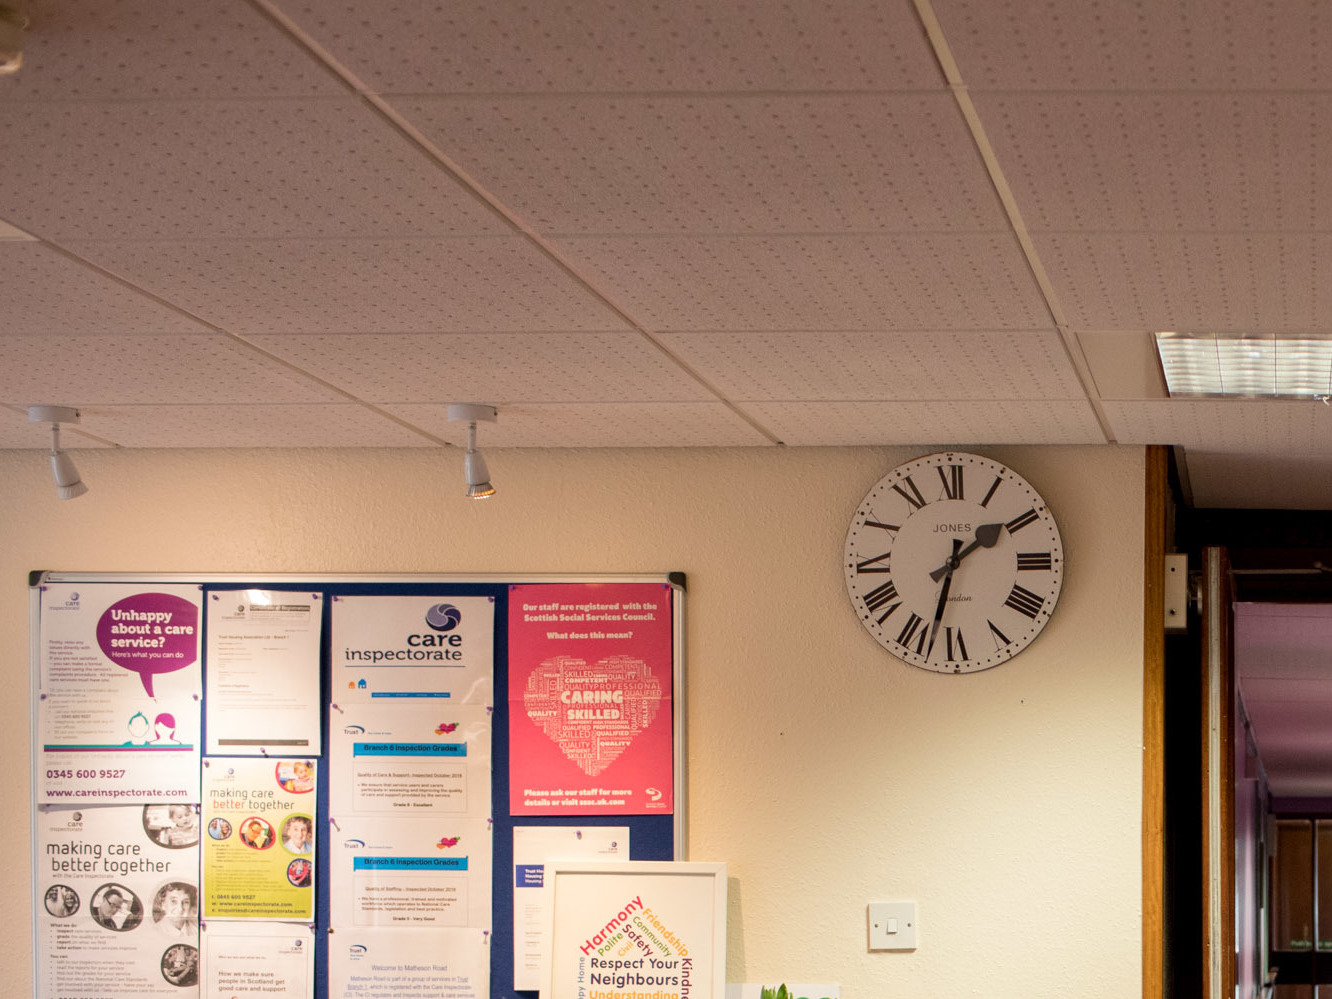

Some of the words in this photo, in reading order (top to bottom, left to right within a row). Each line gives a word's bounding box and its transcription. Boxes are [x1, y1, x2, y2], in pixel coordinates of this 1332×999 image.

[933, 524, 971, 532] JONES
[576, 603, 619, 612] registered
[111, 609, 172, 623] Unhappy
[623, 613, 656, 621] Council.
[111, 623, 150, 634] about
[154, 626, 162, 634] a
[165, 625, 193, 634] care
[111, 637, 165, 647] service?
[407, 634, 462, 647] care
[345, 648, 462, 663] inspectorate
[561, 690, 623, 704] CARING
[567, 710, 620, 719] SKILLED
[558, 730, 590, 738] SKILLED
[46, 770, 73, 778] 0345
[77, 770, 96, 778] 600
[100, 770, 125, 778] 9527
[46, 789, 187, 798] www.careinspectorate.com
[210, 788, 247, 801] making
[252, 790, 273, 798] care
[214, 800, 245, 809] better
[249, 800, 294, 812] together
[47, 841, 101, 858] making
[108, 844, 140, 855] care
[52, 858, 98, 872] better
[104, 858, 171, 876] together
[580, 896, 644, 956] Harmony
[643, 908, 688, 957] Friendship
[622, 924, 653, 957] Safety
[632, 916, 671, 957] Community
[598, 932, 623, 956] Polite
[618, 941, 634, 956] Civil
[591, 958, 644, 971] Respect
[649, 958, 679, 968] Your
[590, 973, 679, 988] Neighbours
